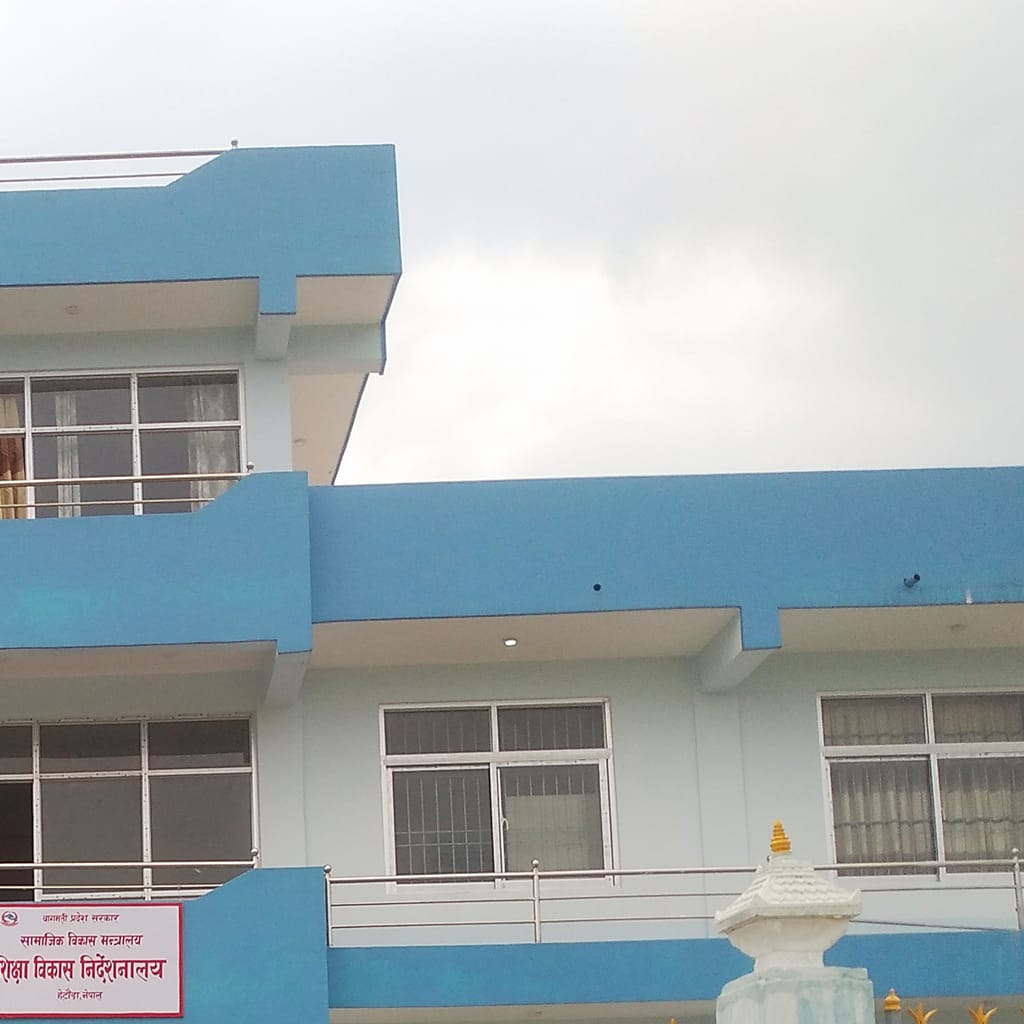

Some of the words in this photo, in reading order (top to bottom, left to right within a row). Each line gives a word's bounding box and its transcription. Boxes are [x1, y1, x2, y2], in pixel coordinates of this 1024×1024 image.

[70, 911, 88, 924] प्रदेश
[91, 914, 119, 924] सरकार
[20, 932, 65, 948] सामाजिक
[68, 931, 97, 947] विकास
[100, 934, 143, 948] मन्त्रालय
[33, 954, 75, 982] विकास
[79, 953, 167, 983] निर्देशनालय
